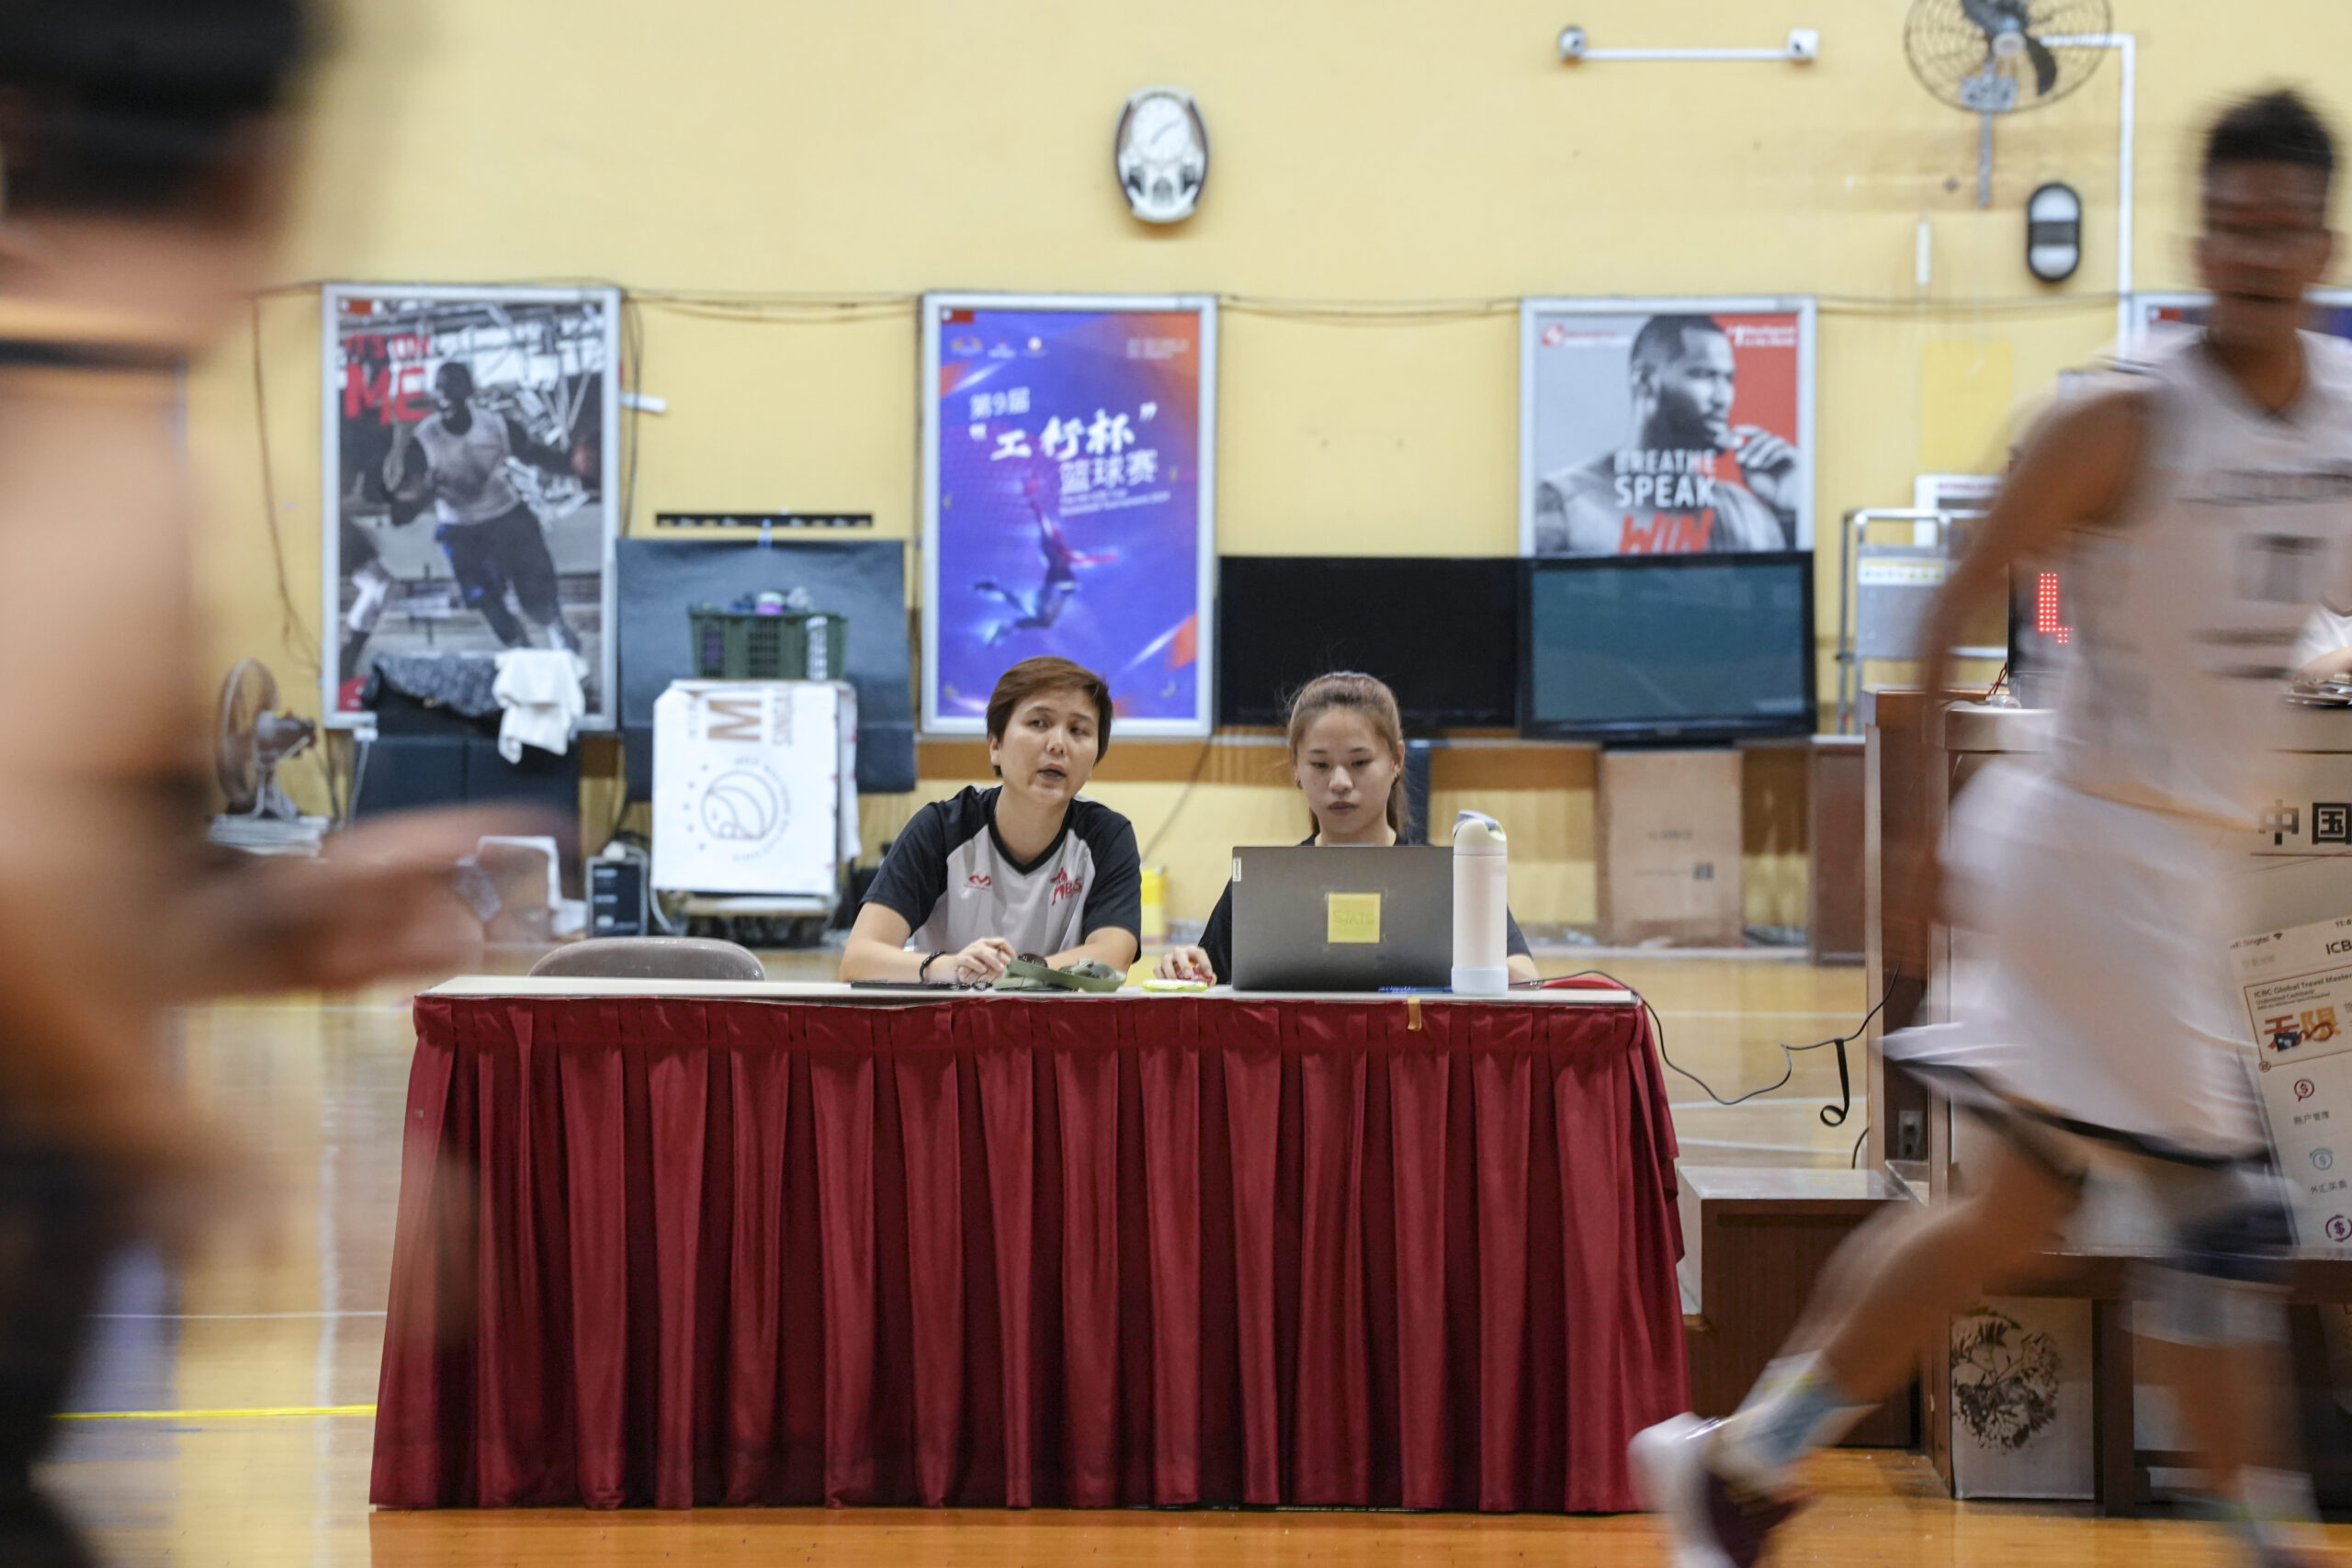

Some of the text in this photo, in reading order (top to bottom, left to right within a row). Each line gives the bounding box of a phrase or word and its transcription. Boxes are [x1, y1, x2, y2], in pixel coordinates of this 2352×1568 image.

[343, 362, 433, 425] ME
[1613, 448, 1717, 475] BREATHE
[1613, 474, 1717, 508] SPEAK
[1619, 509, 1716, 553] WIN
[2257, 798, 2352, 846] 中国
[2274, 982, 2300, 994] Global
[2301, 978, 2324, 989] Travel
